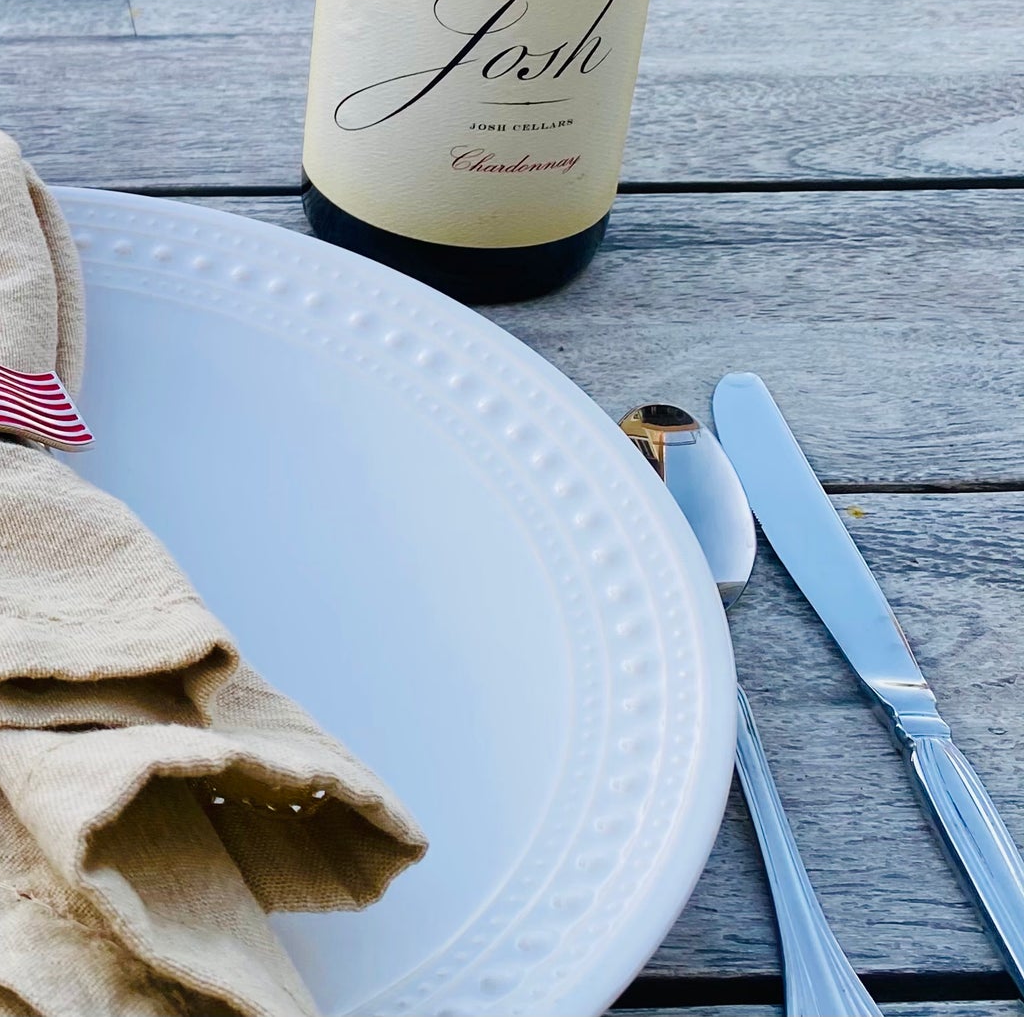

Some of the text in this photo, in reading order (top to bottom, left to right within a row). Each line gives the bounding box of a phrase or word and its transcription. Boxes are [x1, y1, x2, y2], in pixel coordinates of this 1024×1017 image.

[469, 118, 574, 132] JOSH CELLARS
[449, 145, 582, 174] Chardonnay
